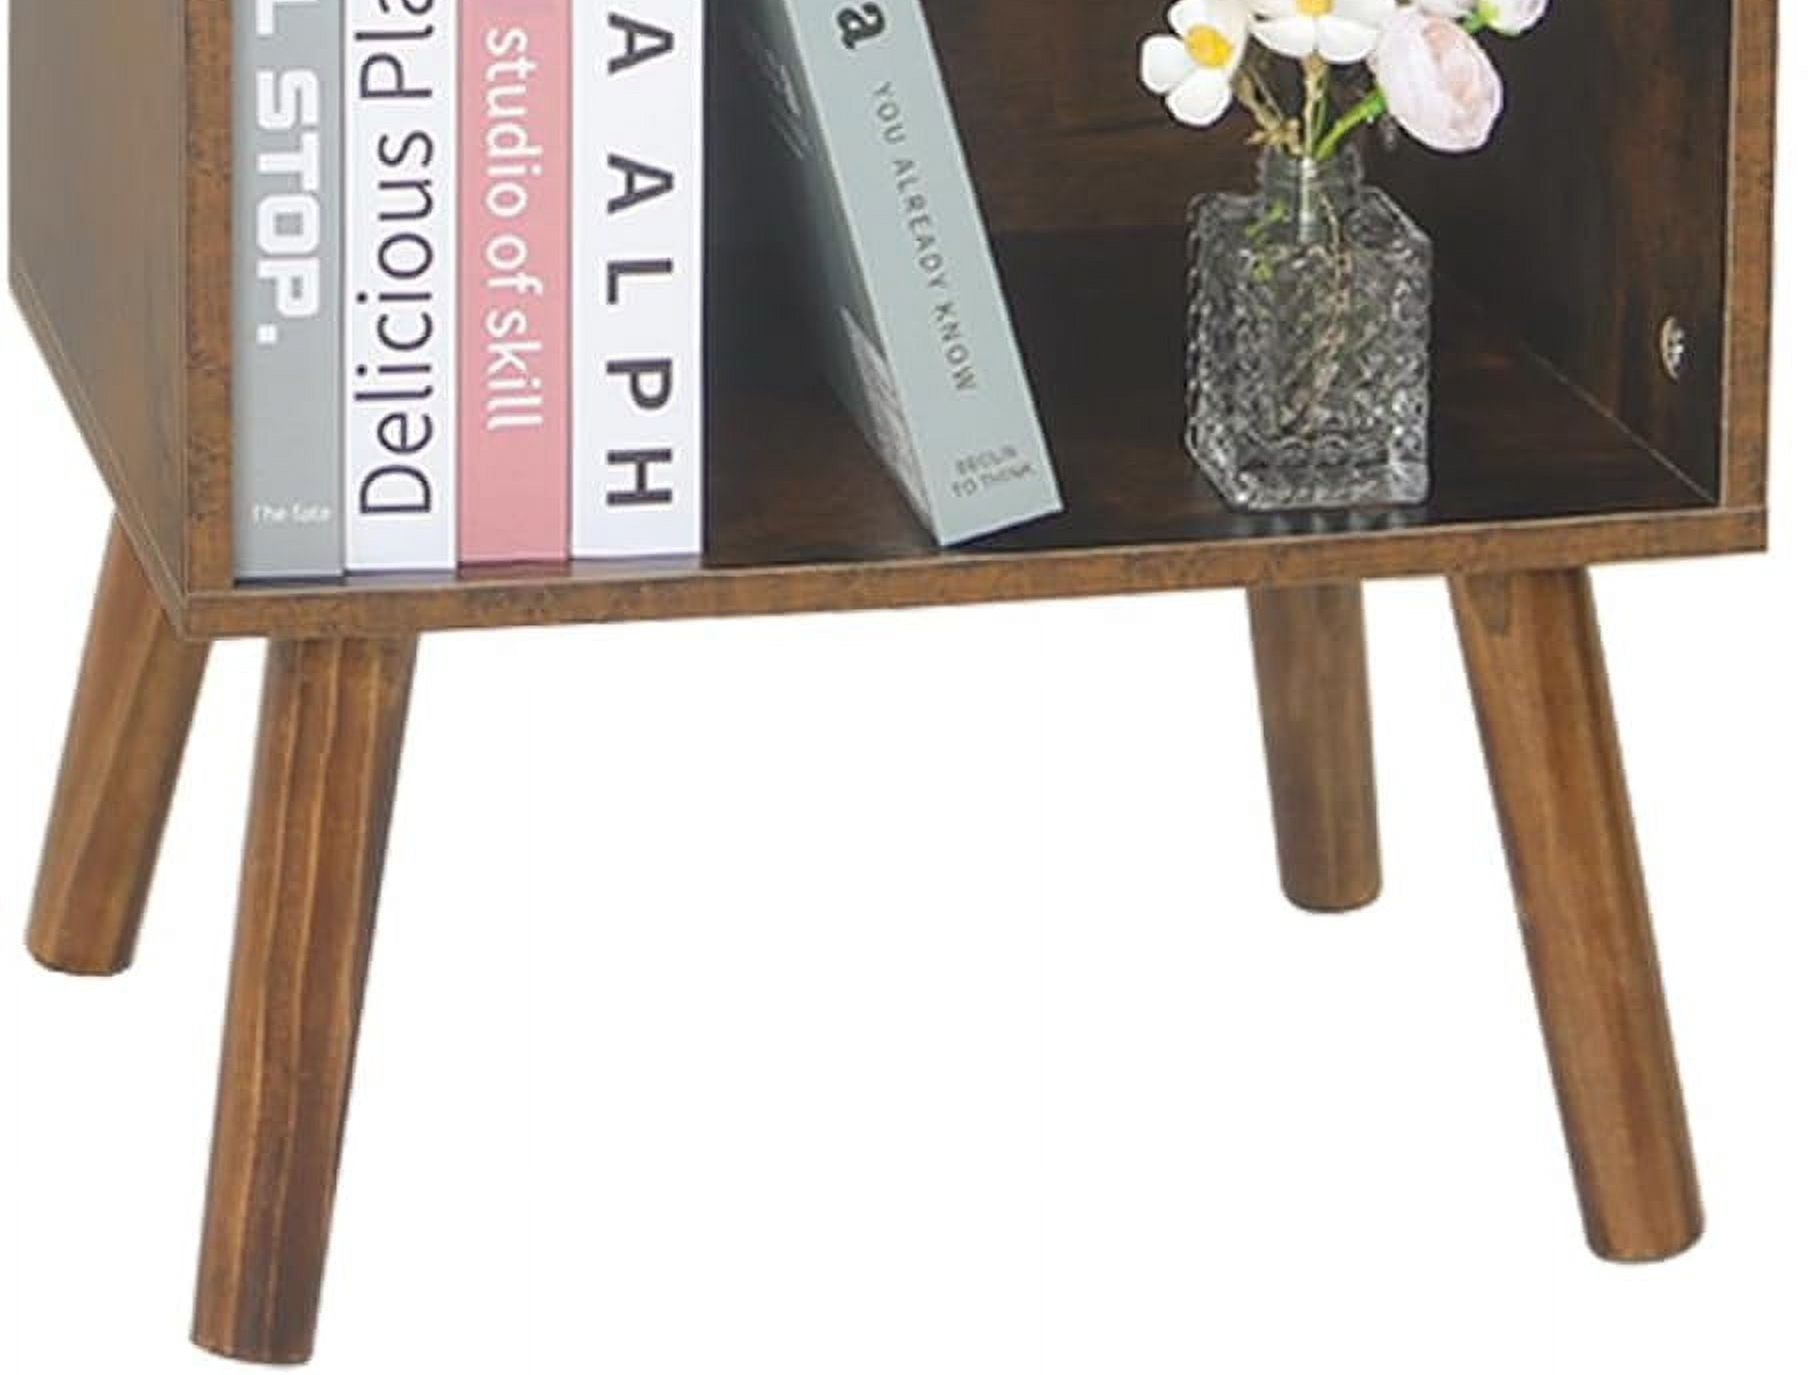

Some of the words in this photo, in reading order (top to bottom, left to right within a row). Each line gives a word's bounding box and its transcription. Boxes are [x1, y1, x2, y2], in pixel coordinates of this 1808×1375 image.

[257, 70, 320, 344] STOP.
[485, 27, 543, 218] studio
[872, 81, 906, 145] YOU
[893, 159, 946, 289] ALREADY
[934, 301, 978, 392] KNOW
[352, 131, 434, 514] Delicious
[485, 309, 543, 431] skill
[486, 234, 543, 296] of
[605, 154, 675, 506] ALPH
